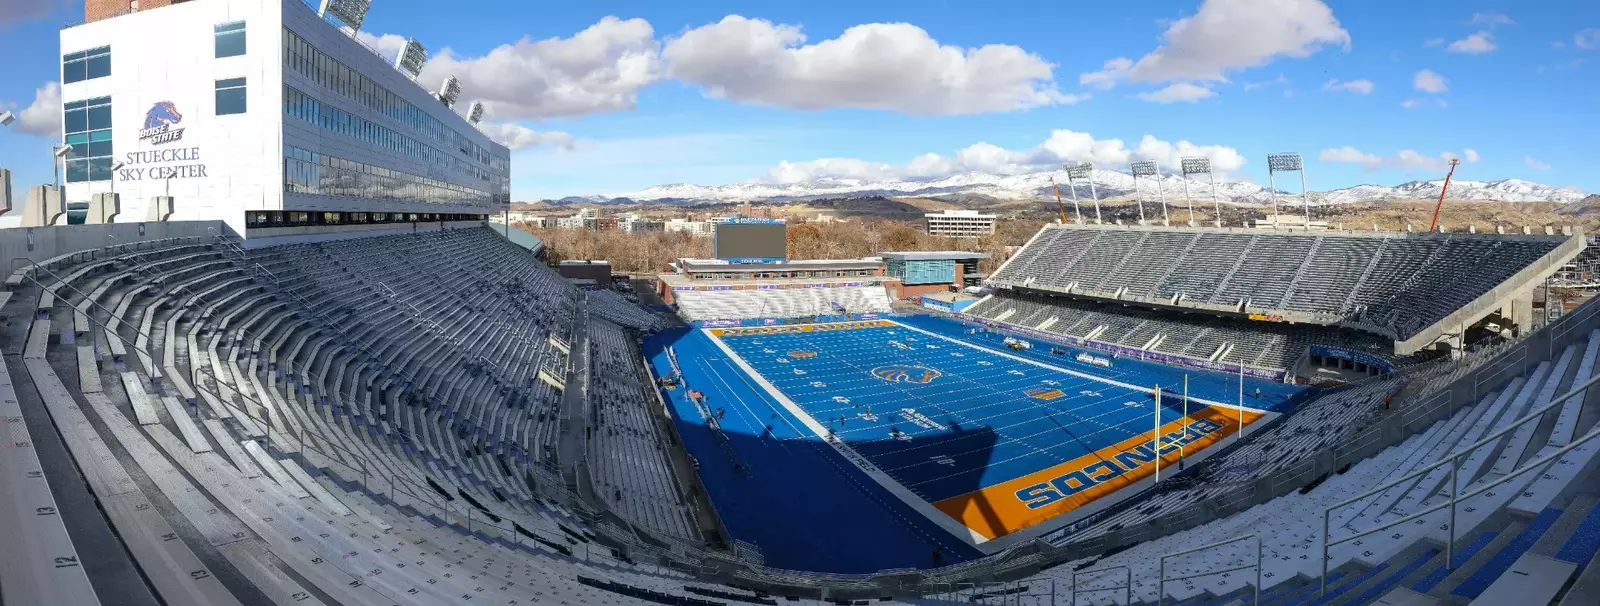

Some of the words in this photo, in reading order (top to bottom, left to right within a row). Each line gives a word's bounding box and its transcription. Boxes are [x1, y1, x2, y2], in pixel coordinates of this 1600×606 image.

[140, 123, 168, 139] BOISE
[152, 128, 183, 145] STATE
[126, 147, 200, 165] STUECKLE
[119, 168, 145, 181] SKY
[149, 163, 208, 180] CENTER
[1014, 418, 1223, 510] BRONCOS
[36, 507, 56, 515] 13
[54, 556, 78, 568] 12
[190, 569, 209, 580] 13
